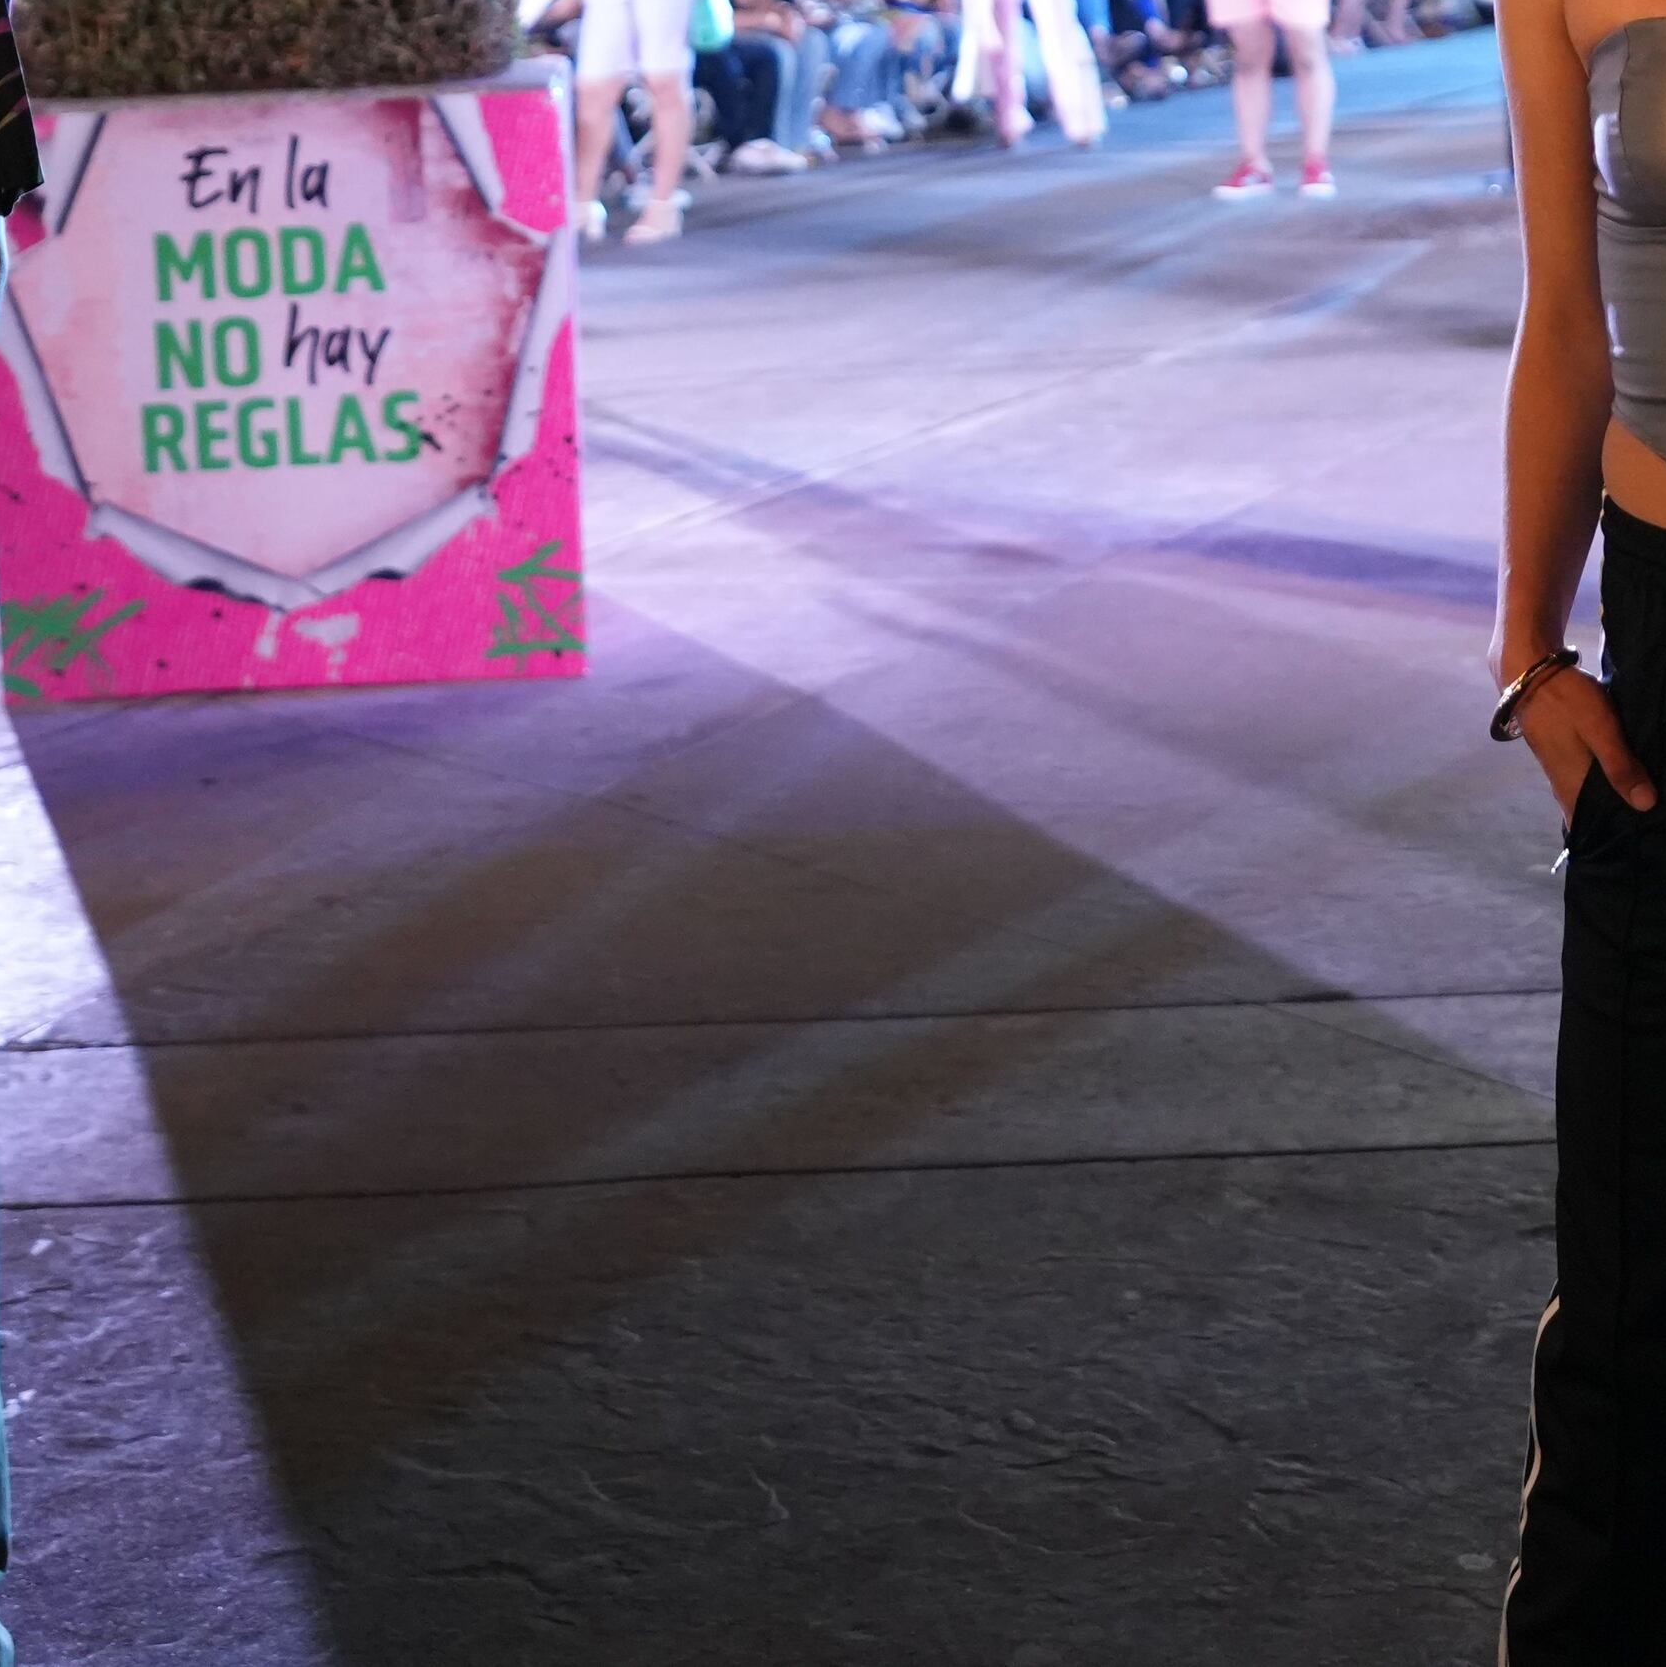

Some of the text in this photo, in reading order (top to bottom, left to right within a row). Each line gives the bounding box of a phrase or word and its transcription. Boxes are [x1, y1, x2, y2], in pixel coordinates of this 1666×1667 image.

[180, 133, 331, 215] En la
[154, 222, 387, 303] MODA
[154, 302, 391, 391] NO hay
[141, 390, 423, 475] REGLAS
